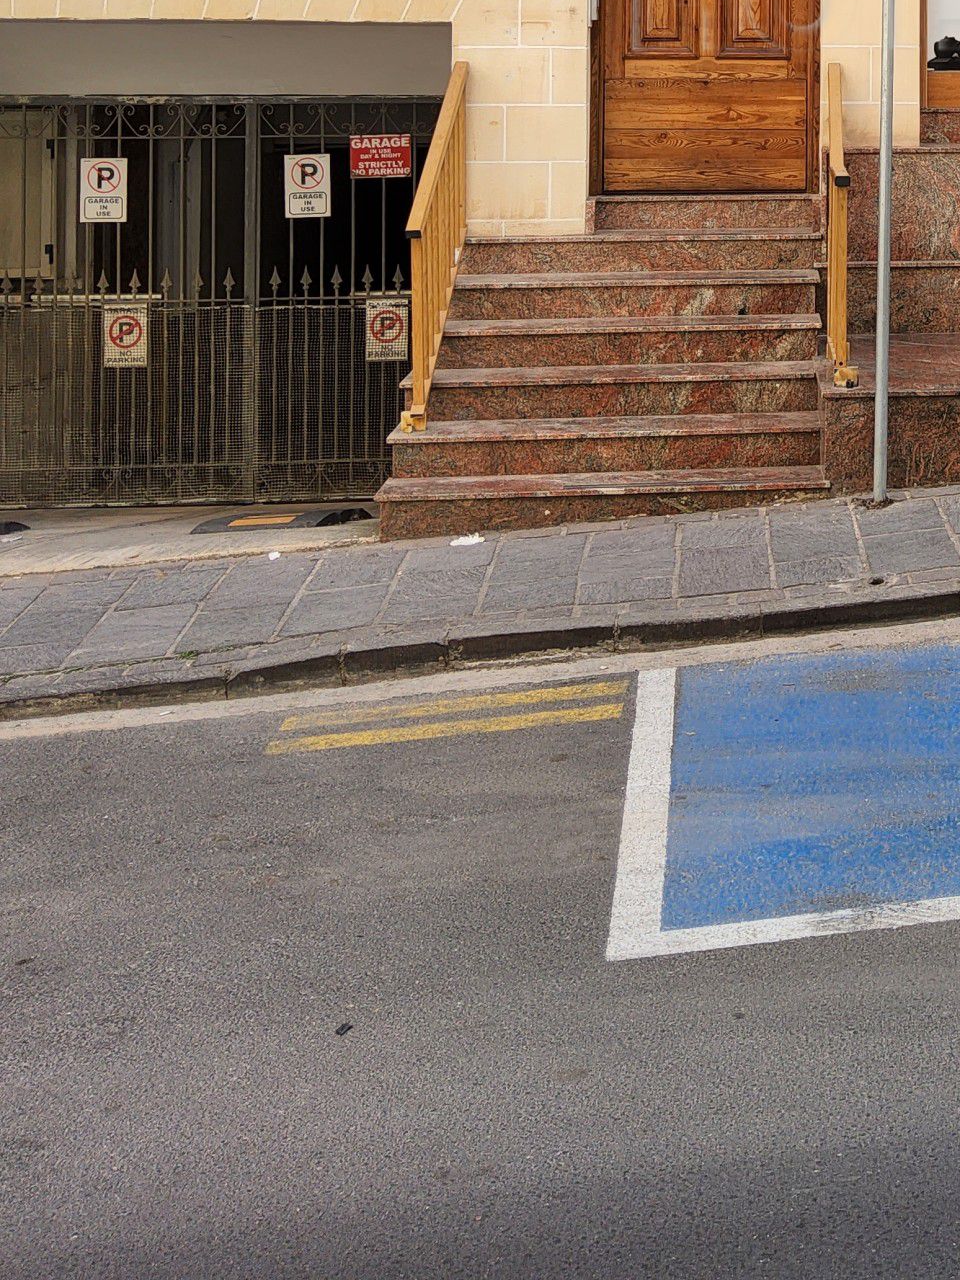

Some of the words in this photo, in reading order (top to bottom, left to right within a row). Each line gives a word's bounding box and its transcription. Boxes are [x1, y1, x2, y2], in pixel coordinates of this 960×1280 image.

[351, 137, 410, 149] GARAGE
[358, 160, 404, 169] STRICTLY
[369, 167, 411, 176] PARKING
